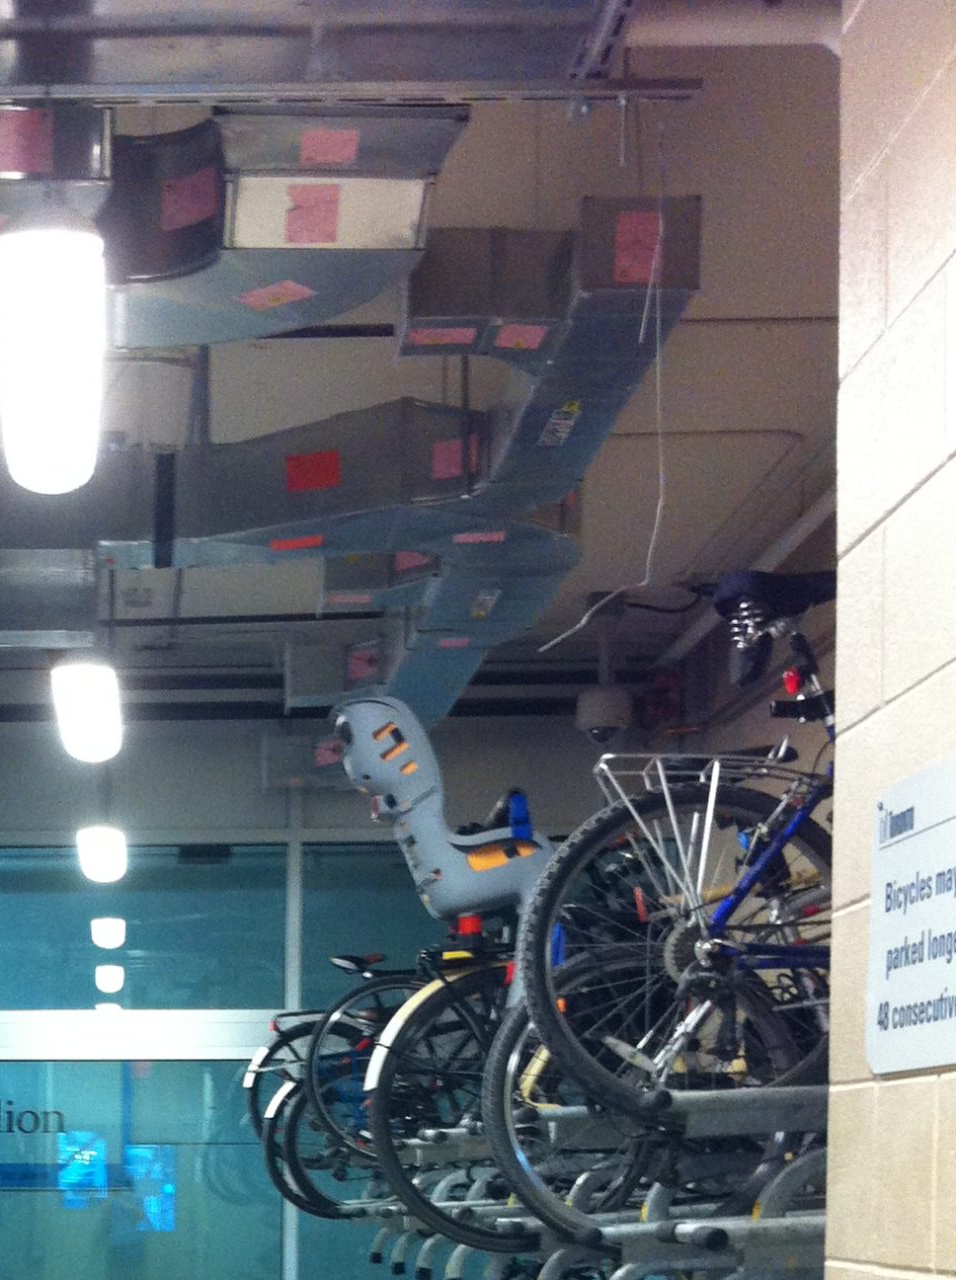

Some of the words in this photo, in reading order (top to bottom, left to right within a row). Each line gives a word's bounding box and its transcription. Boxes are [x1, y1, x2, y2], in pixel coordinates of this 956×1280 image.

[885, 871, 933, 915] Bicycles
[886, 930, 924, 980] parked
[878, 1001, 889, 1031] 48
[892, 987, 956, 1029] consecutiv
